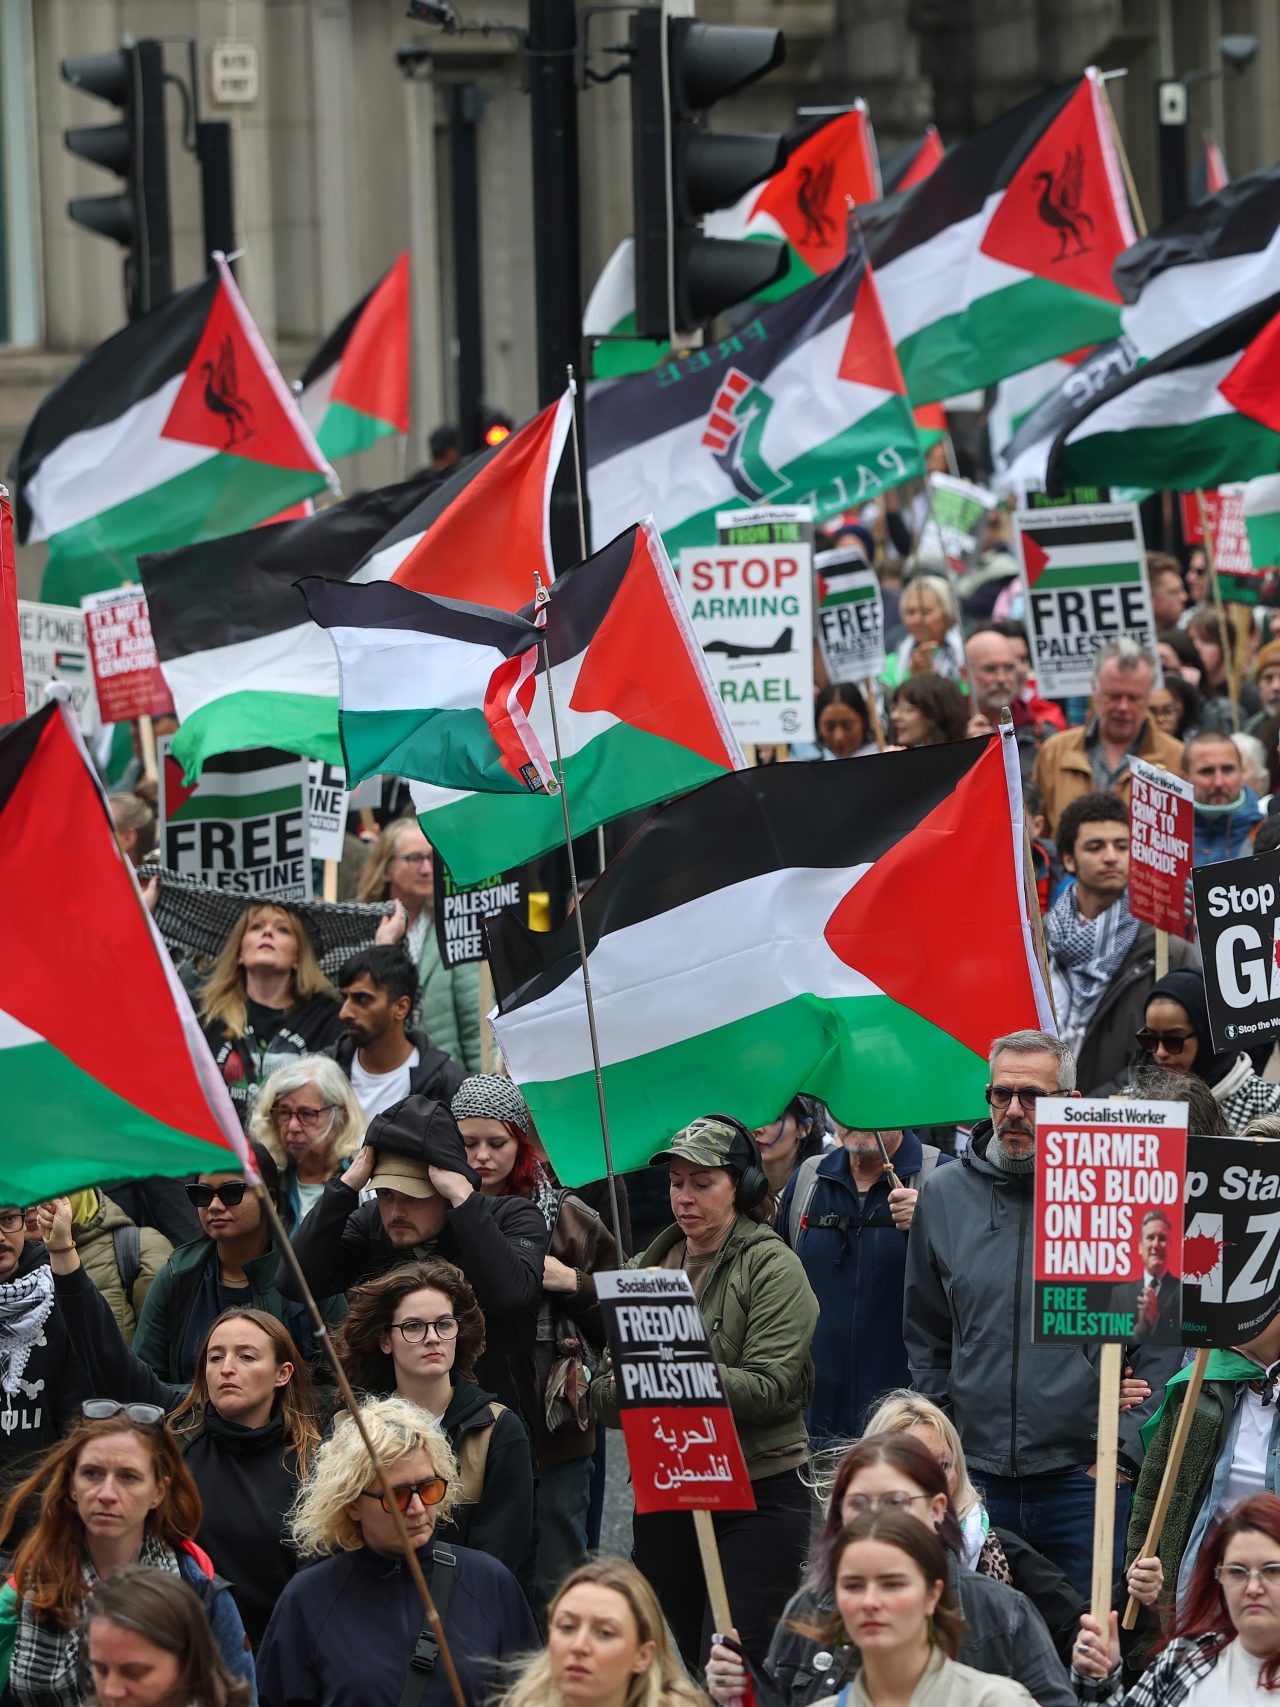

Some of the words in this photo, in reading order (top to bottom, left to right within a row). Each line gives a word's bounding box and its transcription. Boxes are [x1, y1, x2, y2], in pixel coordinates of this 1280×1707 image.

[692, 558, 798, 592] STOP
[691, 596, 800, 620] ARMING
[1029, 586, 1148, 636] FREE
[37, 615, 86, 646] POWE
[720, 678, 801, 703] RAEL
[1132, 777, 1149, 799] IT'S
[1150, 787, 1169, 813] NOT
[1171, 795, 1179, 817] A
[1132, 798, 1158, 830] CRIME
[1160, 811, 1176, 835] TO
[166, 811, 304, 870] FREE
[1131, 839, 1178, 877] GENOCIDE
[1150, 828, 1190, 863] AGAINST
[444, 881, 521, 919] PALESTINE
[1207, 883, 1275, 918] Stop
[444, 913, 482, 941] WILL
[446, 935, 484, 964] FREE
[1238, 1024, 1257, 1034] Stop
[1257, 1020, 1271, 1030] the
[1063, 1106, 1124, 1124] Socialist
[1124, 1107, 1167, 1125] Worker
[1045, 1131, 1161, 1168] STARMER
[1045, 1167, 1097, 1204] HAS
[1105, 1168, 1179, 1206] BLOOD
[1044, 1203, 1082, 1239] ON
[1090, 1204, 1133, 1240] HIS
[1044, 1239, 1132, 1276] HANDS
[616, 1277, 657, 1294] Socialist
[1042, 1286, 1088, 1311] FREE
[614, 1304, 706, 1343] FREEDOM
[1042, 1311, 1135, 1337] PALESTINE
[658, 1342, 674, 1362] for
[621, 1361, 723, 1400] PALESTINE
[1, 1407, 42, 1431] ULI
[651, 1415, 717, 1454] الحرية
[653, 1452, 734, 1490] لفلسطين
